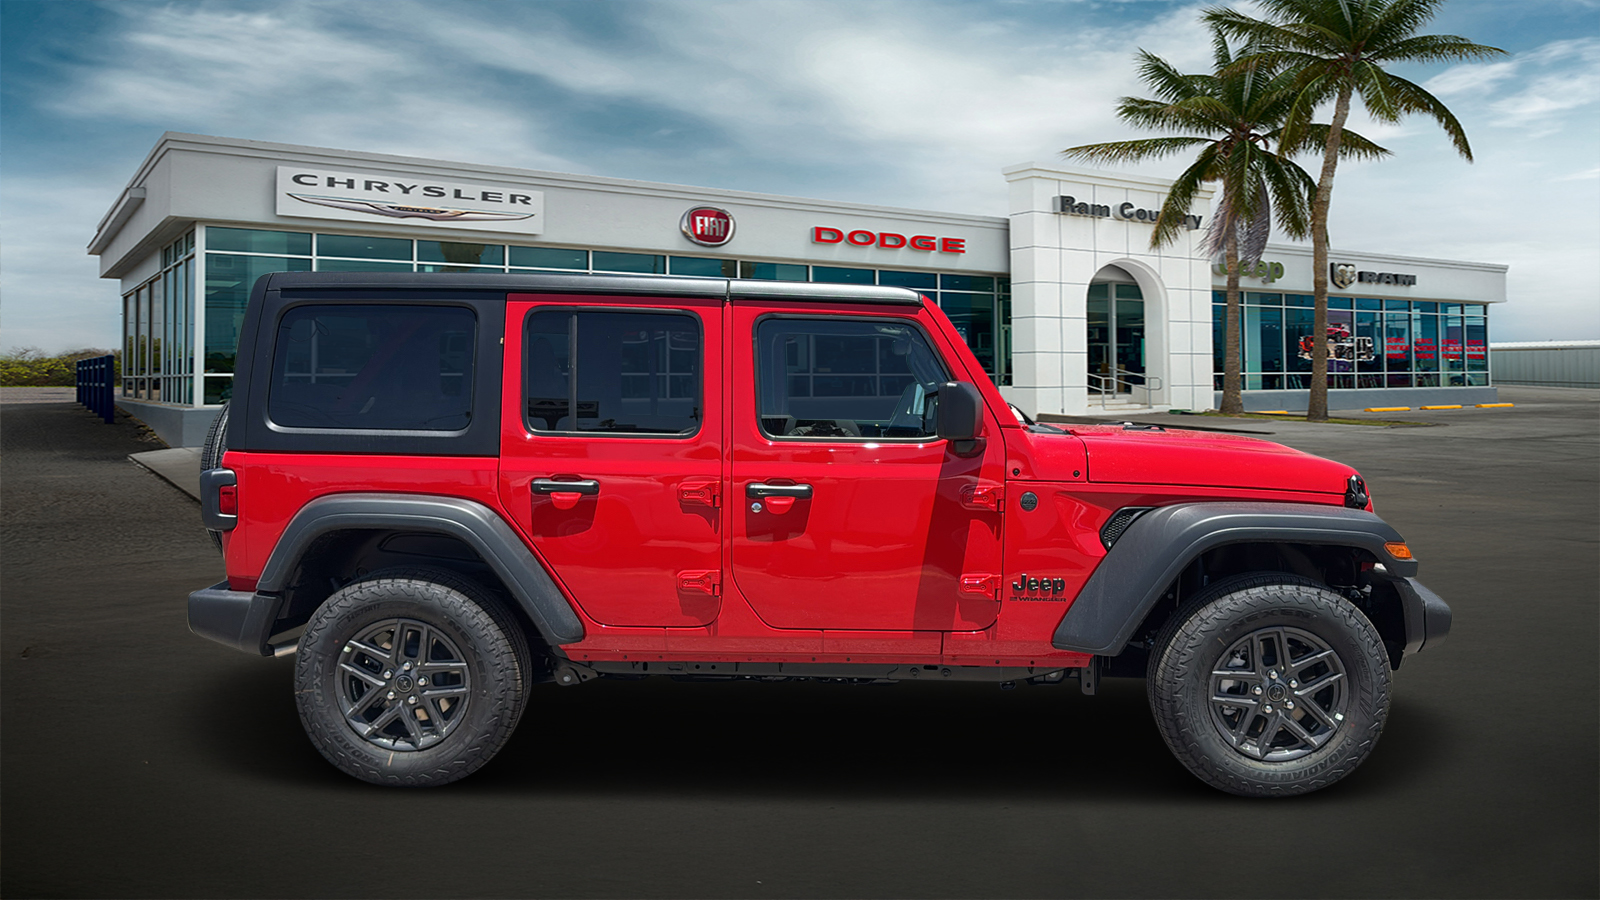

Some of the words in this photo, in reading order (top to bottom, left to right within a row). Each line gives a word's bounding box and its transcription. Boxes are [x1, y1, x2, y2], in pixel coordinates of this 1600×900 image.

[291, 173, 533, 206] CHRYSLER
[1053, 195, 1111, 218] Ram
[694, 215, 728, 238] FIAT
[811, 225, 967, 254] DODGE
[1358, 270, 1417, 287] RAM
[1012, 573, 1066, 595] Jeep
[1230, 608, 1310, 630] NEXEN
